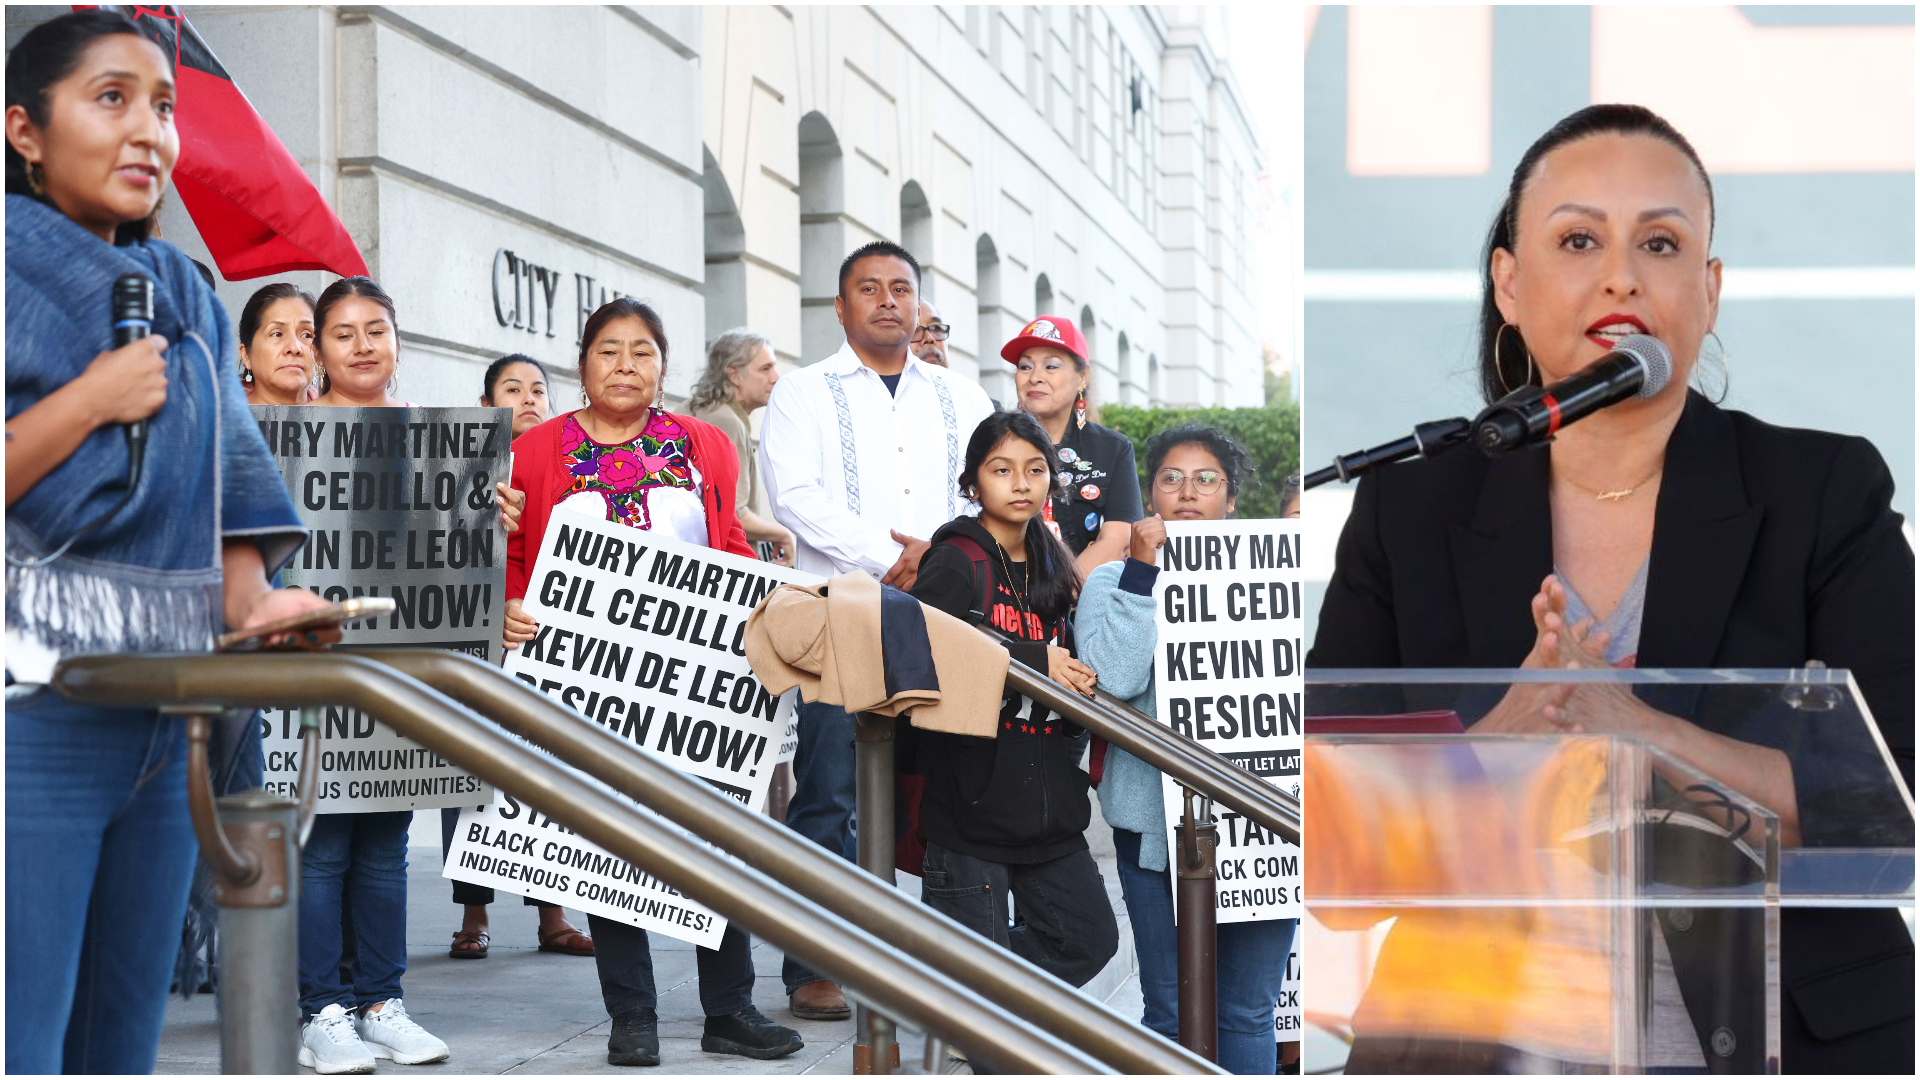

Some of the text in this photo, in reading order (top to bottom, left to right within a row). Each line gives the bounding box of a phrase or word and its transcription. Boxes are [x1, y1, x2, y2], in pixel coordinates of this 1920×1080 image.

[492, 247, 561, 338] CITY
[258, 421, 498, 458] URY MARTINEZ
[303, 470, 494, 511] CEDILLO &
[351, 529, 396, 570] DE
[406, 519, 494, 569] LEÓN
[552, 523, 788, 609] NURY MARTIN
[1163, 535, 1241, 572] NURY
[390, 584, 491, 631] NOW!
[539, 570, 595, 618] GIL
[1164, 584, 1217, 624] GIL
[521, 622, 780, 723] KEVIN DE LEÓN
[1166, 640, 1264, 682] KEVIN
[1169, 692, 1300, 741] RESIGN
[656, 711, 768, 778] NOW!
[1231, 758, 1251, 772] OT
[1254, 757, 1275, 771] LET
[348, 775, 482, 799] COMMUNITIES!
[467, 822, 538, 857] BLACK
[459, 850, 713, 933] INDIGENOUS COMMUNITIES!
